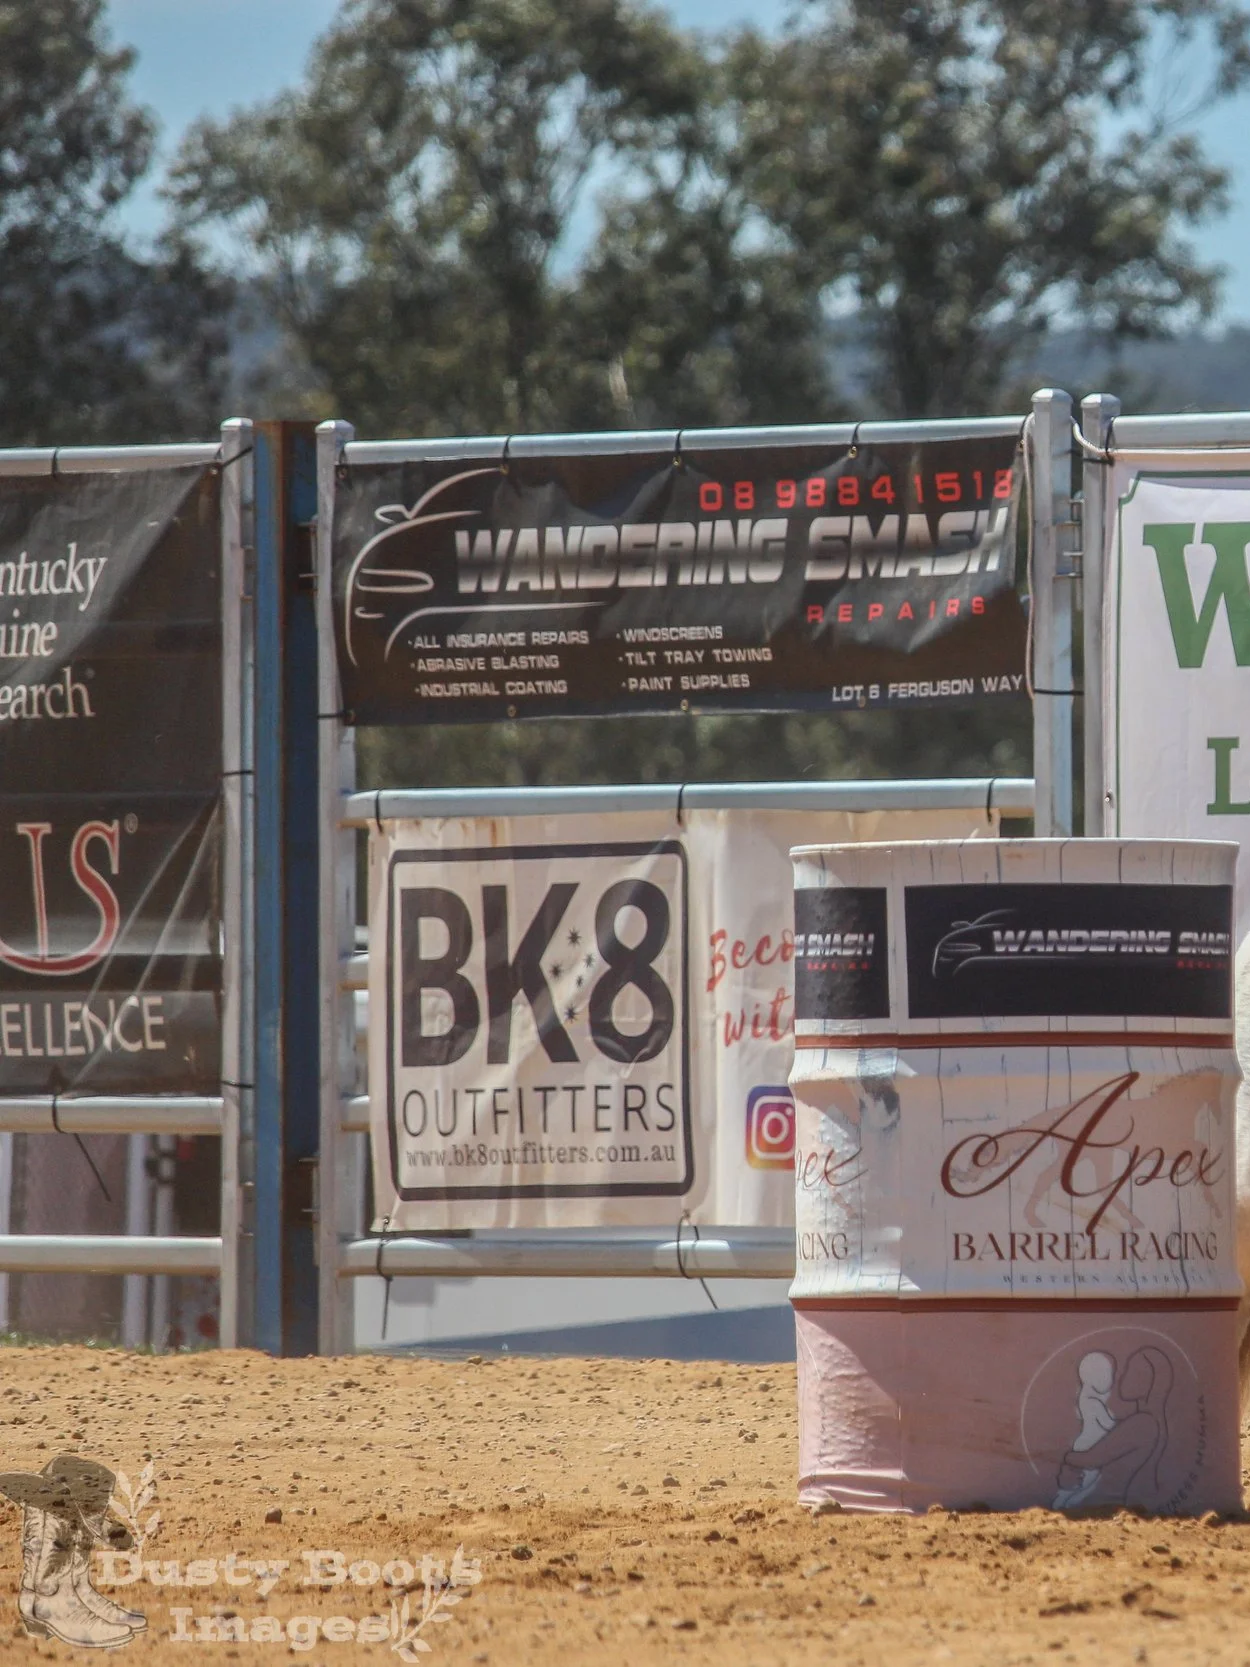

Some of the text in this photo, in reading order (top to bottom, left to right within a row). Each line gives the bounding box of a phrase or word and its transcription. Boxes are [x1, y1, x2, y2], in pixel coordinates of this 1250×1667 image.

[700, 469, 1013, 511] 08 9884 1518
[455, 507, 1009, 593] WANDERING SMASH
[807, 597, 985, 624] REPAIRS
[414, 630, 589, 649] ALL INSURANCE REPAIRS
[624, 626, 723, 641] WINDSCREENS
[417, 655, 560, 672] ABRASIVE BLASTING
[626, 648, 772, 666] TILT TRAY TOWING
[421, 679, 568, 697] INDUSTRIAL COATING
[628, 674, 751, 691] PAINT SUPPLIES
[832, 675, 1023, 702] LOT 6 FERGUSON WAY
[992, 930, 1171, 953] WANDERING
[401, 878, 675, 1067] BK8
[402, 1083, 677, 1137] OUTFITTERS
[406, 1140, 676, 1168] www.bk8outfitters.com.au
[941, 1072, 1226, 1235] Apex
[953, 1231, 1218, 1262] BARREL RACING
